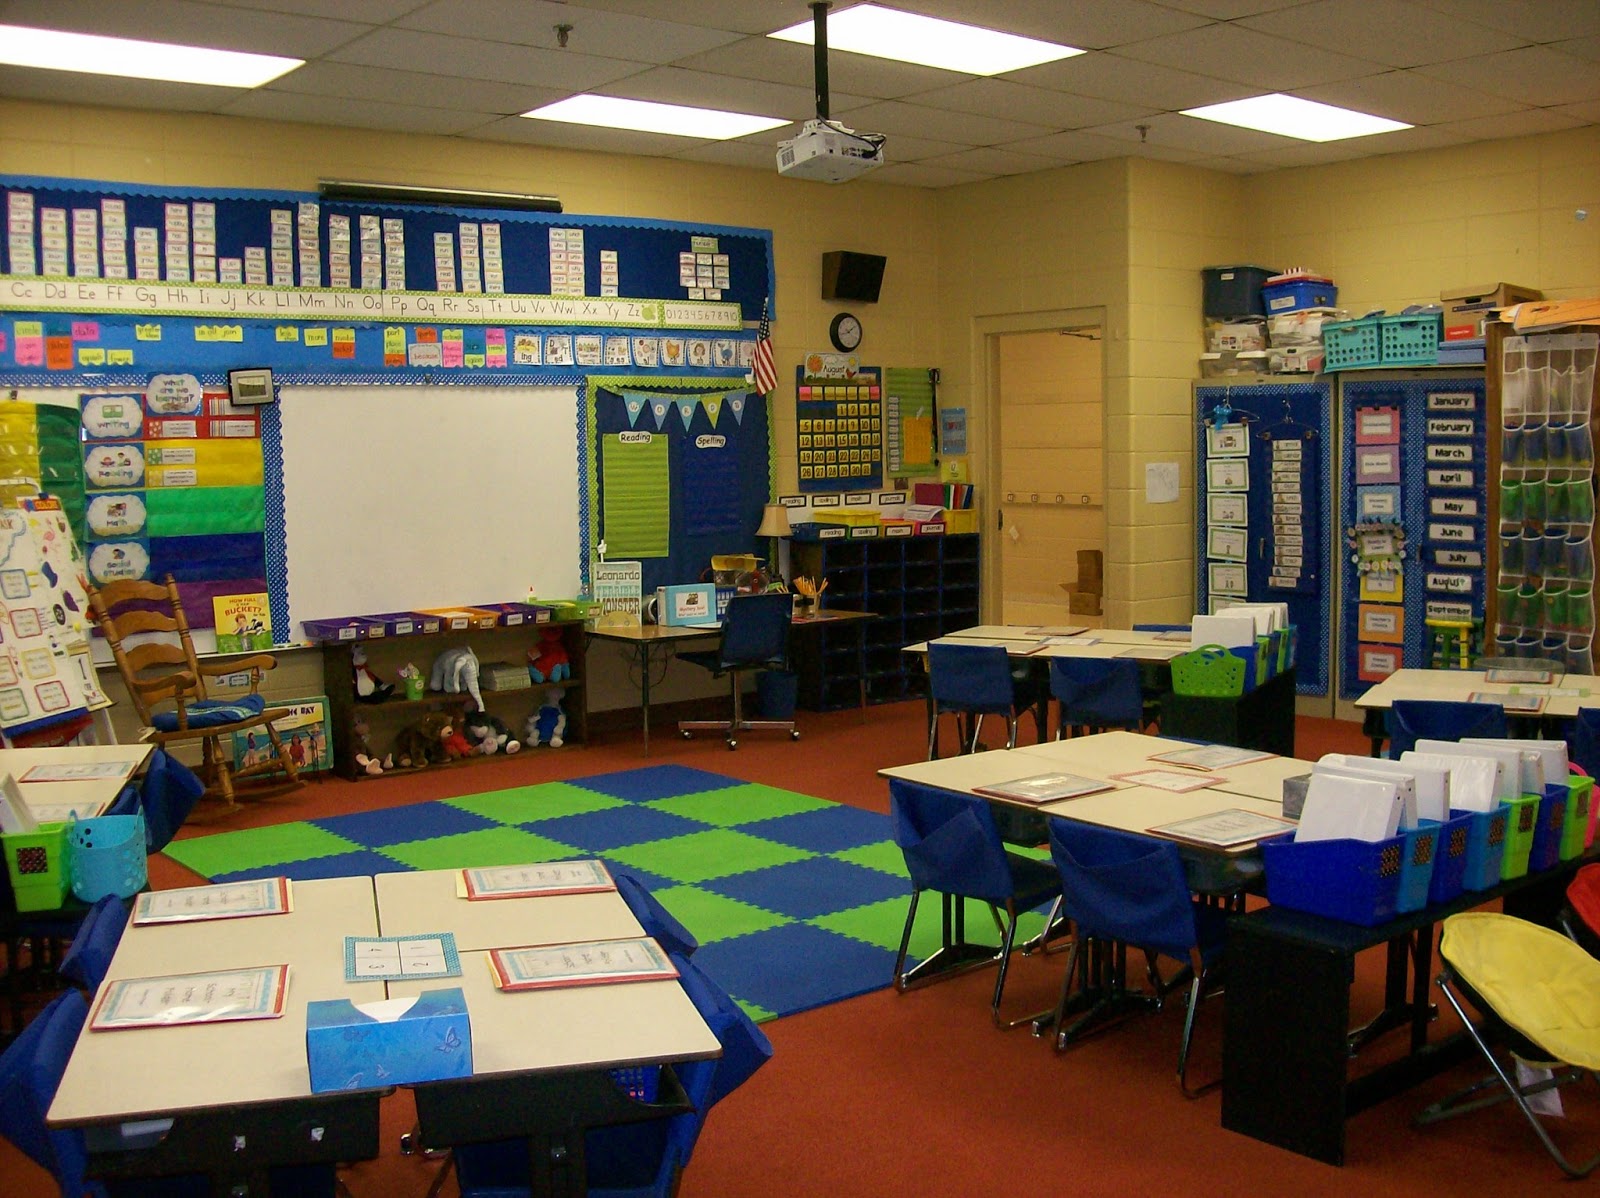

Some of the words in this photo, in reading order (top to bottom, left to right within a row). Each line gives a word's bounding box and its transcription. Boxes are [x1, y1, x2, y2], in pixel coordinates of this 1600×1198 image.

[11, 282, 32, 298] Cc
[44, 283, 66, 299] Dd
[78, 284, 96, 300] Ee
[107, 286, 123, 300] Ff
[136, 287, 157, 308] Gg
[168, 289, 188, 303] Hh
[221, 291, 236, 311] Jj
[246, 292, 265, 306] Kk
[300, 294, 325, 308] Mm
[335, 294, 353, 308] Nn
[363, 296, 382, 309] Oo
[392, 297, 407, 315] Pp
[417, 298, 437, 316] Qq
[443, 298, 458, 311] Rr
[468, 299, 479, 312] Ss
[489, 300, 501, 312] Tt
[511, 301, 526, 313] Uu
[531, 301, 545, 313] Vv
[551, 302, 573, 314] Ww
[583, 303, 597, 314] Xx
[606, 303, 619, 320] Yy
[628, 304, 640, 316] Zz
[823, 365, 844, 375] August
[1434, 397, 1469, 406] January
[841, 406, 843, 414] 1
[851, 406, 855, 414] 2
[804, 422, 808, 430] 5
[829, 422, 832, 430] 7
[851, 421, 854, 430] 9
[862, 421, 868, 429] 10
[1431, 423, 1471, 432] February
[621, 434, 650, 442] Reading
[698, 437, 724, 446] Spelling
[802, 437, 809, 445] 12
[816, 437, 822, 445] 13
[839, 436, 846, 444] 15
[863, 436, 868, 444] 17
[803, 453, 810, 461] 19
[815, 453, 823, 461] 20
[829, 453, 834, 461] 21
[840, 452, 847, 460] 22
[851, 452, 858, 460] 23
[1436, 449, 1464, 457] March
[803, 468, 811, 477] 26
[816, 468, 823, 476] 27
[829, 468, 836, 476] 28
[841, 467, 847, 476] 29
[852, 466, 859, 474] 30
[1440, 473, 1461, 483] April
[1444, 503, 1463, 512] May
[1440, 528, 1462, 536] June
[1449, 554, 1467, 562] July
[597, 571, 639, 580] Leonardo
[597, 598, 639, 615] MONSTER
[1428, 605, 1470, 615] September
[225, 607, 262, 616] BUCKET?
